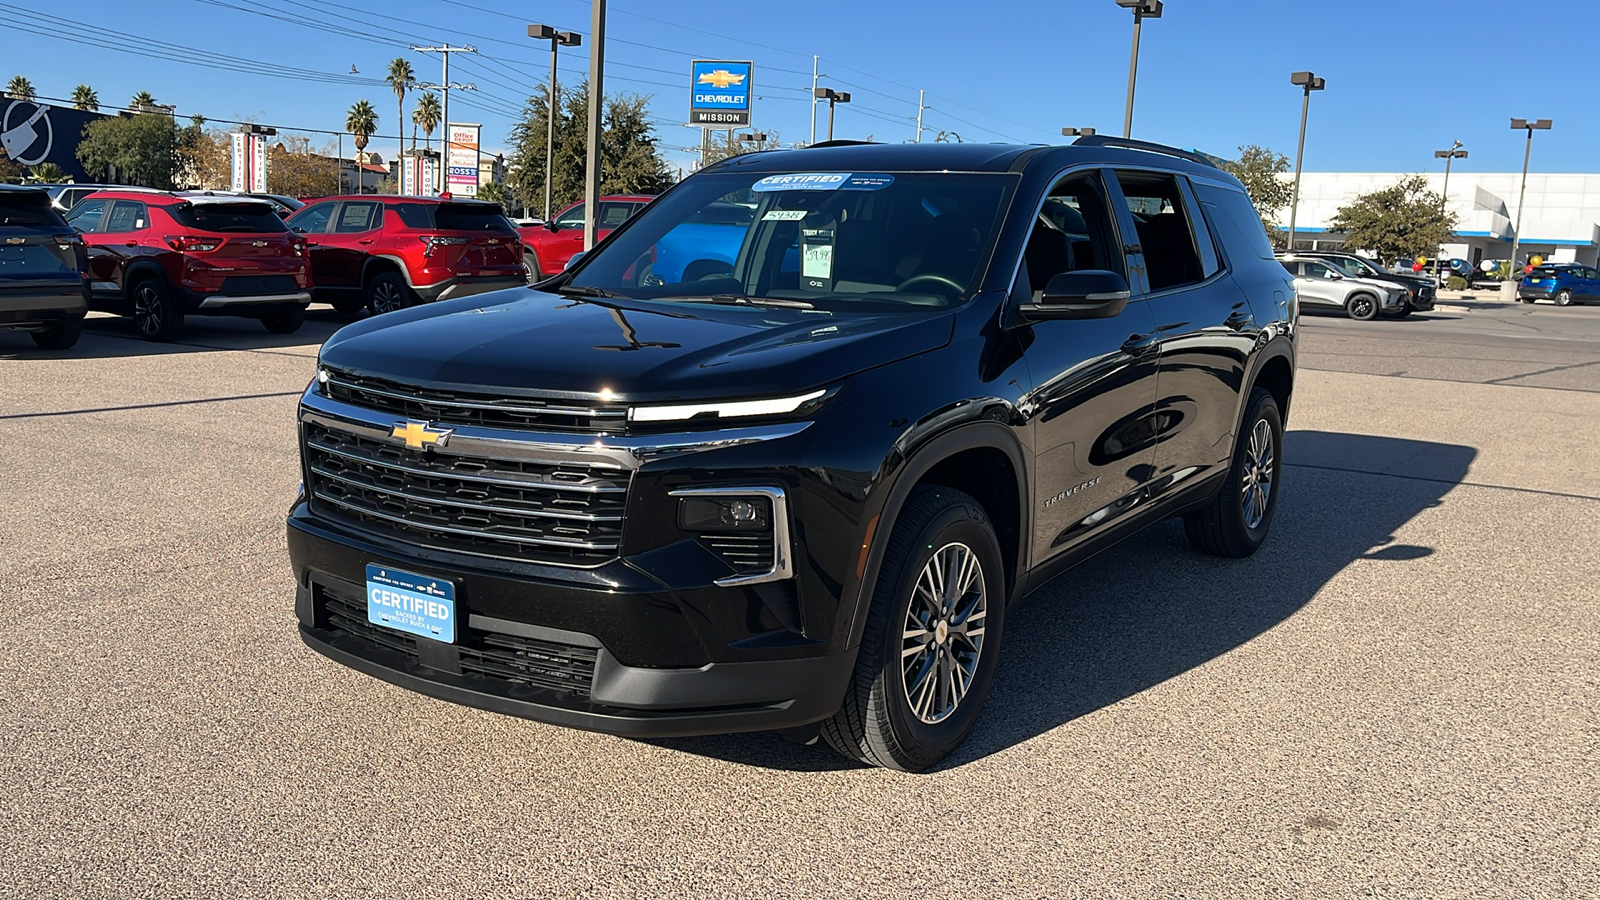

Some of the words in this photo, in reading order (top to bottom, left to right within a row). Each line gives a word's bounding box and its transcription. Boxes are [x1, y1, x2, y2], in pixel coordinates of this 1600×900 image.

[695, 94, 745, 104] CHEVROLET
[699, 113, 740, 122] MISSION
[449, 167, 471, 175] ROSS
[761, 175, 843, 185] CERTIFIED
[1044, 476, 1102, 507] TRAVERSE
[371, 588, 449, 620] CERTIFIED
[377, 611, 409, 625] CHEVROLET
[409, 619, 426, 629] BUICK
[395, 610, 417, 620] BACKED
[417, 615, 426, 623] BY
